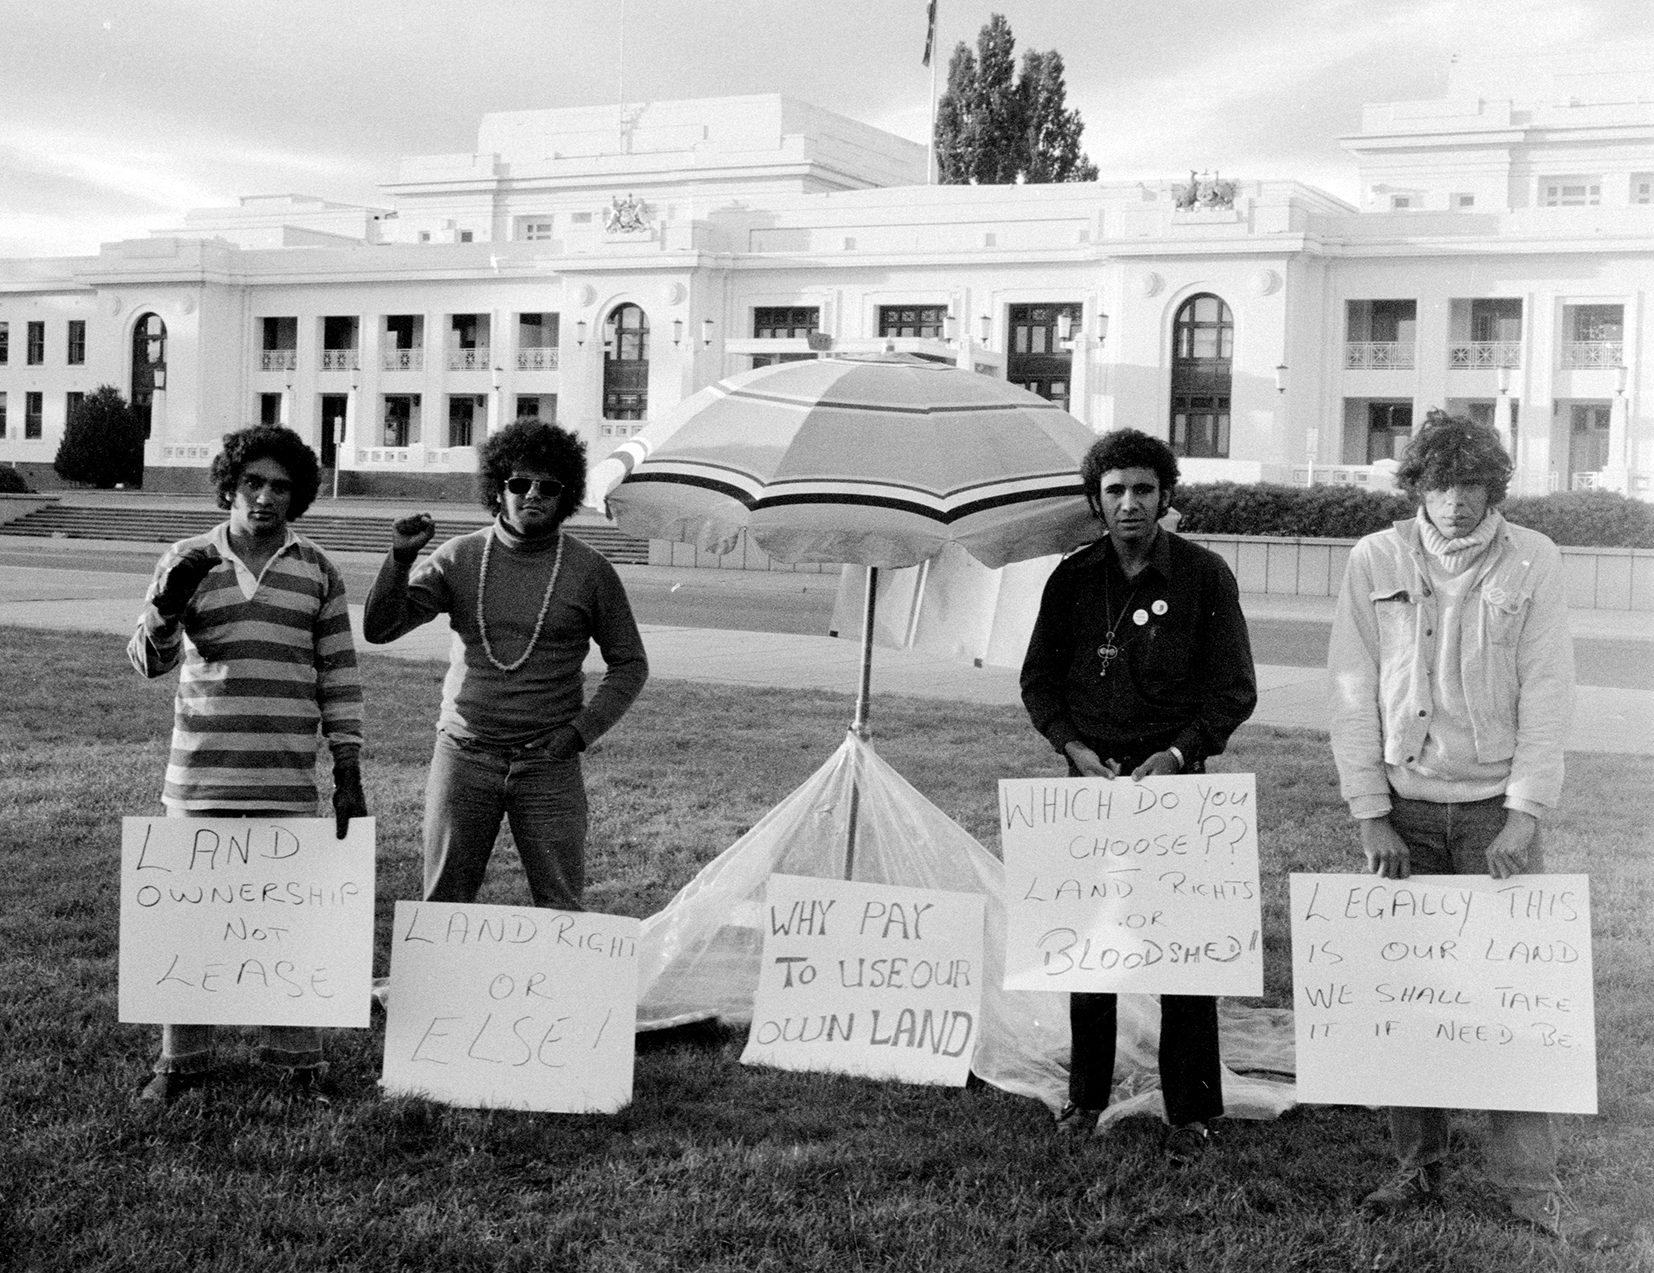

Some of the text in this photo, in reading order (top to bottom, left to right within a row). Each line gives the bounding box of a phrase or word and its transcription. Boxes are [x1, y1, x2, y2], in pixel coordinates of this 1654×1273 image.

[1004, 786, 1112, 830] WHICH
[1133, 784, 1180, 815] DO
[136, 824, 300, 872] LAND
[136, 882, 359, 907] OWNERSHIP
[1024, 871, 1254, 901] LAND RIGHTS
[770, 899, 934, 940] WHY PAY
[1305, 882, 1578, 937] LEGALLY THIS
[404, 908, 637, 958] LAND RIGHT
[1308, 938, 1580, 965] IS OUR LAND
[156, 954, 335, 998] LEASE
[489, 972, 554, 1000] OR
[1305, 983, 1572, 1012] WE SHALL TAKE
[757, 1008, 973, 1058] OWN LAND
[1310, 1022, 1338, 1040] IT
[1375, 1020, 1401, 1037] IF
[1436, 1020, 1514, 1045] NEED
